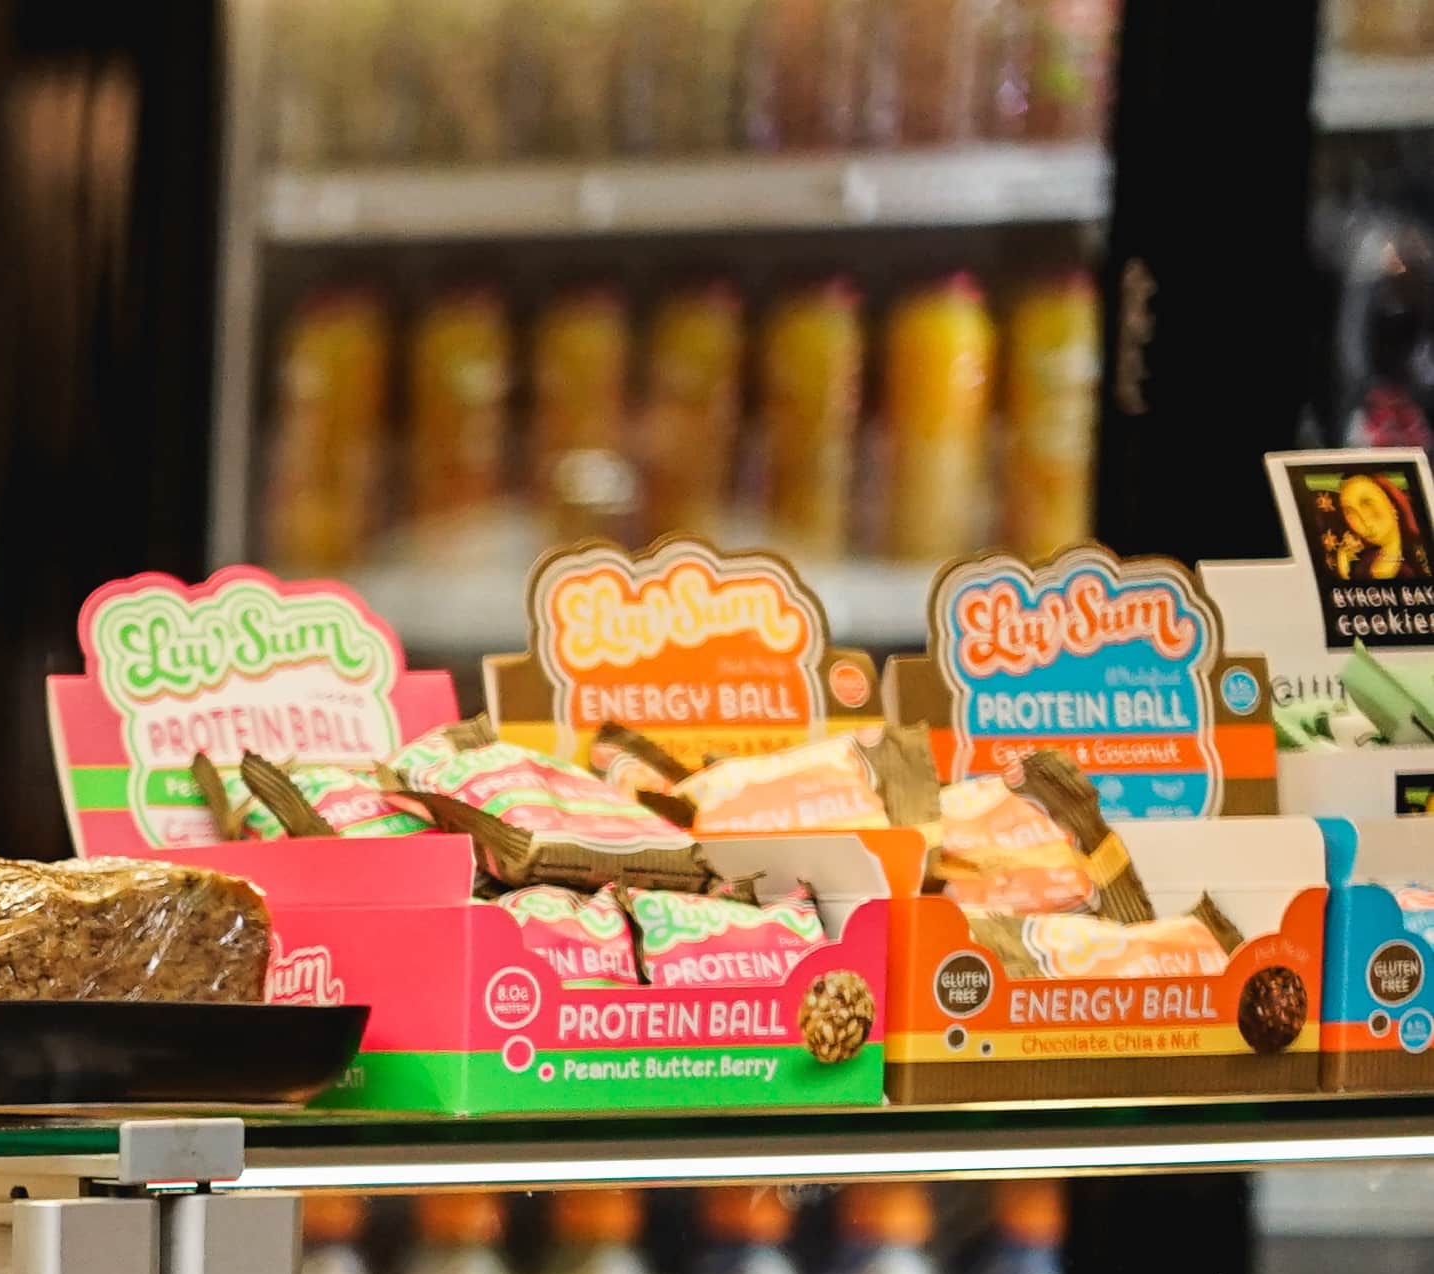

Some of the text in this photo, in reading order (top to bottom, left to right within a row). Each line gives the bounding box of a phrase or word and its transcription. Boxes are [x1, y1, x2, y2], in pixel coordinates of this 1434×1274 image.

[1333, 586, 1398, 608] BYRON
[234, 605, 366, 671] Sum
[1065, 583, 1183, 659] Sum
[579, 684, 798, 722] ENERGY BALL
[976, 690, 1108, 731] PROTEIN
[1113, 690, 1191, 728] BALL
[148, 704, 373, 758] PROTEIN BALL
[662, 952, 784, 987] PROTEIN
[939, 971, 990, 989] GLUTEN
[1373, 960, 1420, 978] GLUTEN
[1380, 977, 1410, 994] FREE
[948, 988, 980, 1006] FREE
[1008, 984, 1218, 1025] ENERGY BALL
[558, 999, 788, 1041] PROTEIN BALL
[1021, 1030, 1109, 1055] Chocolate
[1113, 1029, 1154, 1053] Chia
[1170, 1029, 1202, 1051] Nut
[563, 1058, 641, 1081] Peanut
